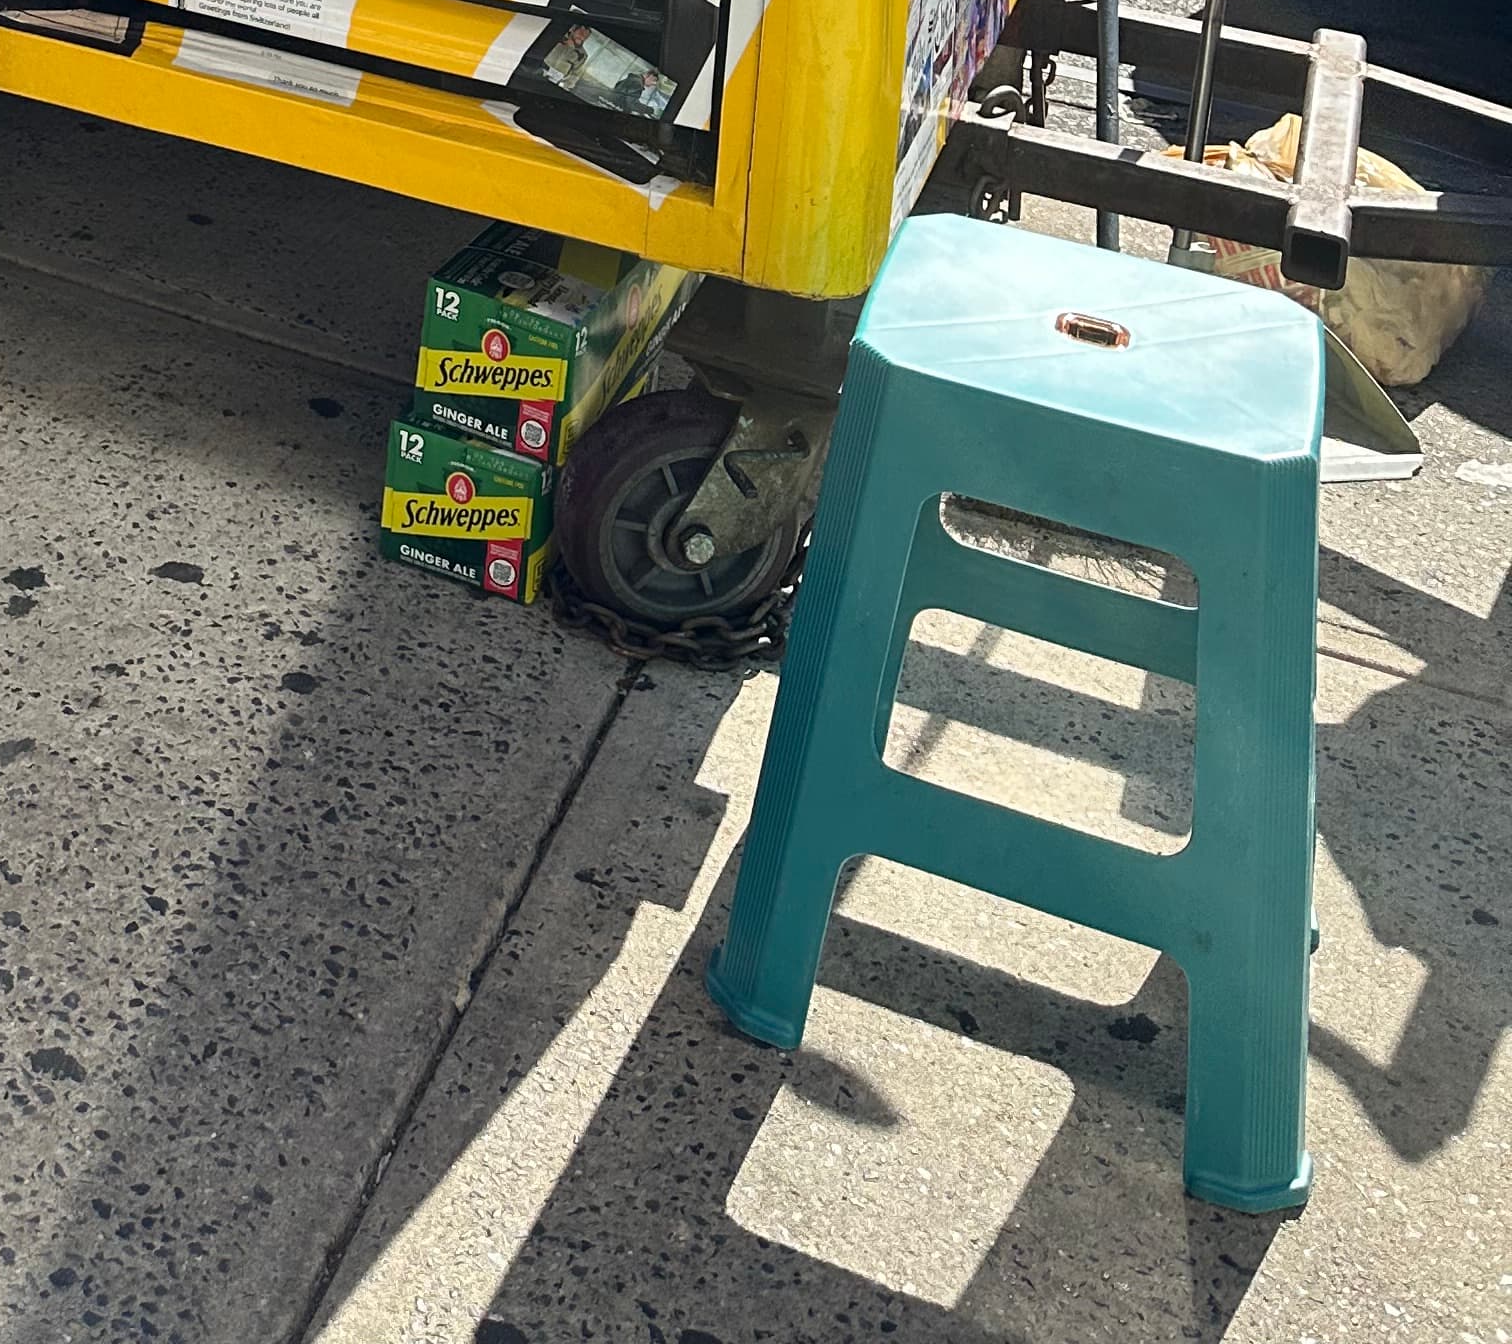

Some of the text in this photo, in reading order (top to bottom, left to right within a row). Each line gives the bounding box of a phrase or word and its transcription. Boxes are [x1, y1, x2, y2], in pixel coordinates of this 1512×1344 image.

[435, 286, 461, 314] 12
[436, 308, 459, 322] PACK
[435, 356, 554, 391] Schweppes
[432, 403, 509, 441] GINGER ALE
[399, 429, 425, 457] 12
[400, 451, 423, 465] PACK
[401, 499, 521, 533] Schweppes
[400, 543, 476, 579] GINGER ALE
